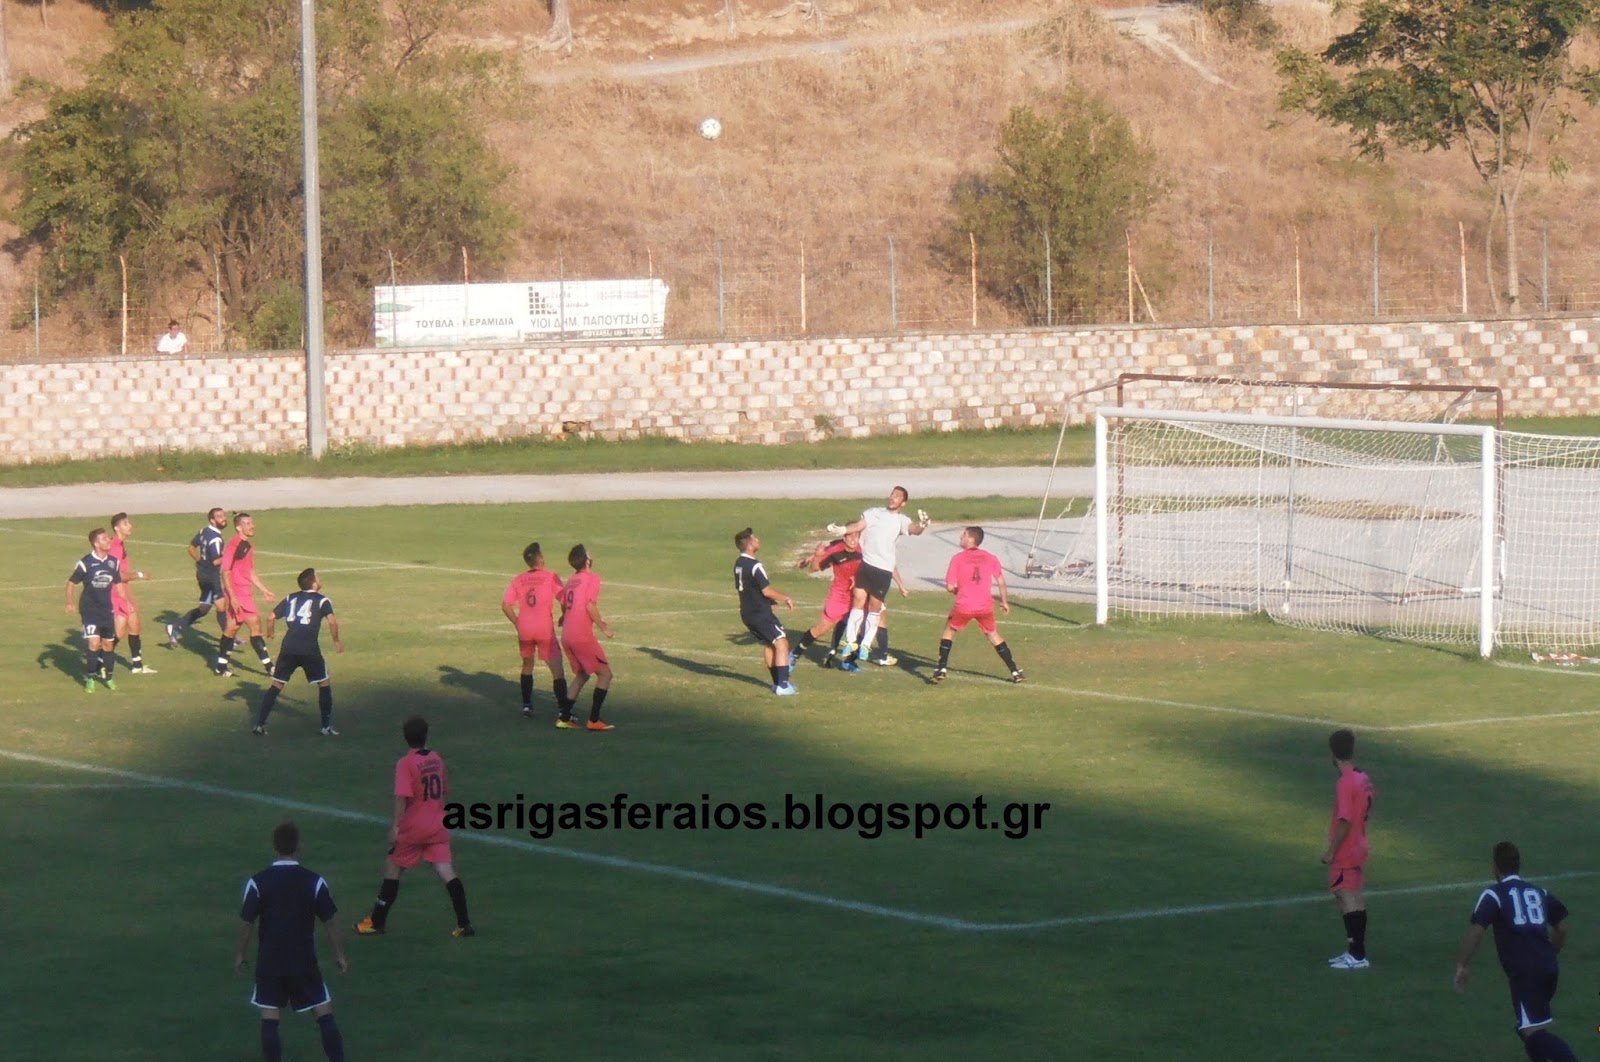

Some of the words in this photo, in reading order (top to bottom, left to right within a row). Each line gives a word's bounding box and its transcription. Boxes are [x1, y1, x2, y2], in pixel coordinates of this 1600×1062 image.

[415, 319, 454, 328] ΤΟΥΒΛΑ
[530, 318, 551, 328] ΥΙΟΙ
[583, 314, 639, 326] ΠΑΠΟΥΤΣΗ
[971, 566, 981, 585] 4
[526, 587, 537, 608] 6
[286, 599, 313, 625] 14
[86, 624, 97, 634] 17
[421, 774, 442, 801] 10
[1508, 887, 1545, 925] 18
